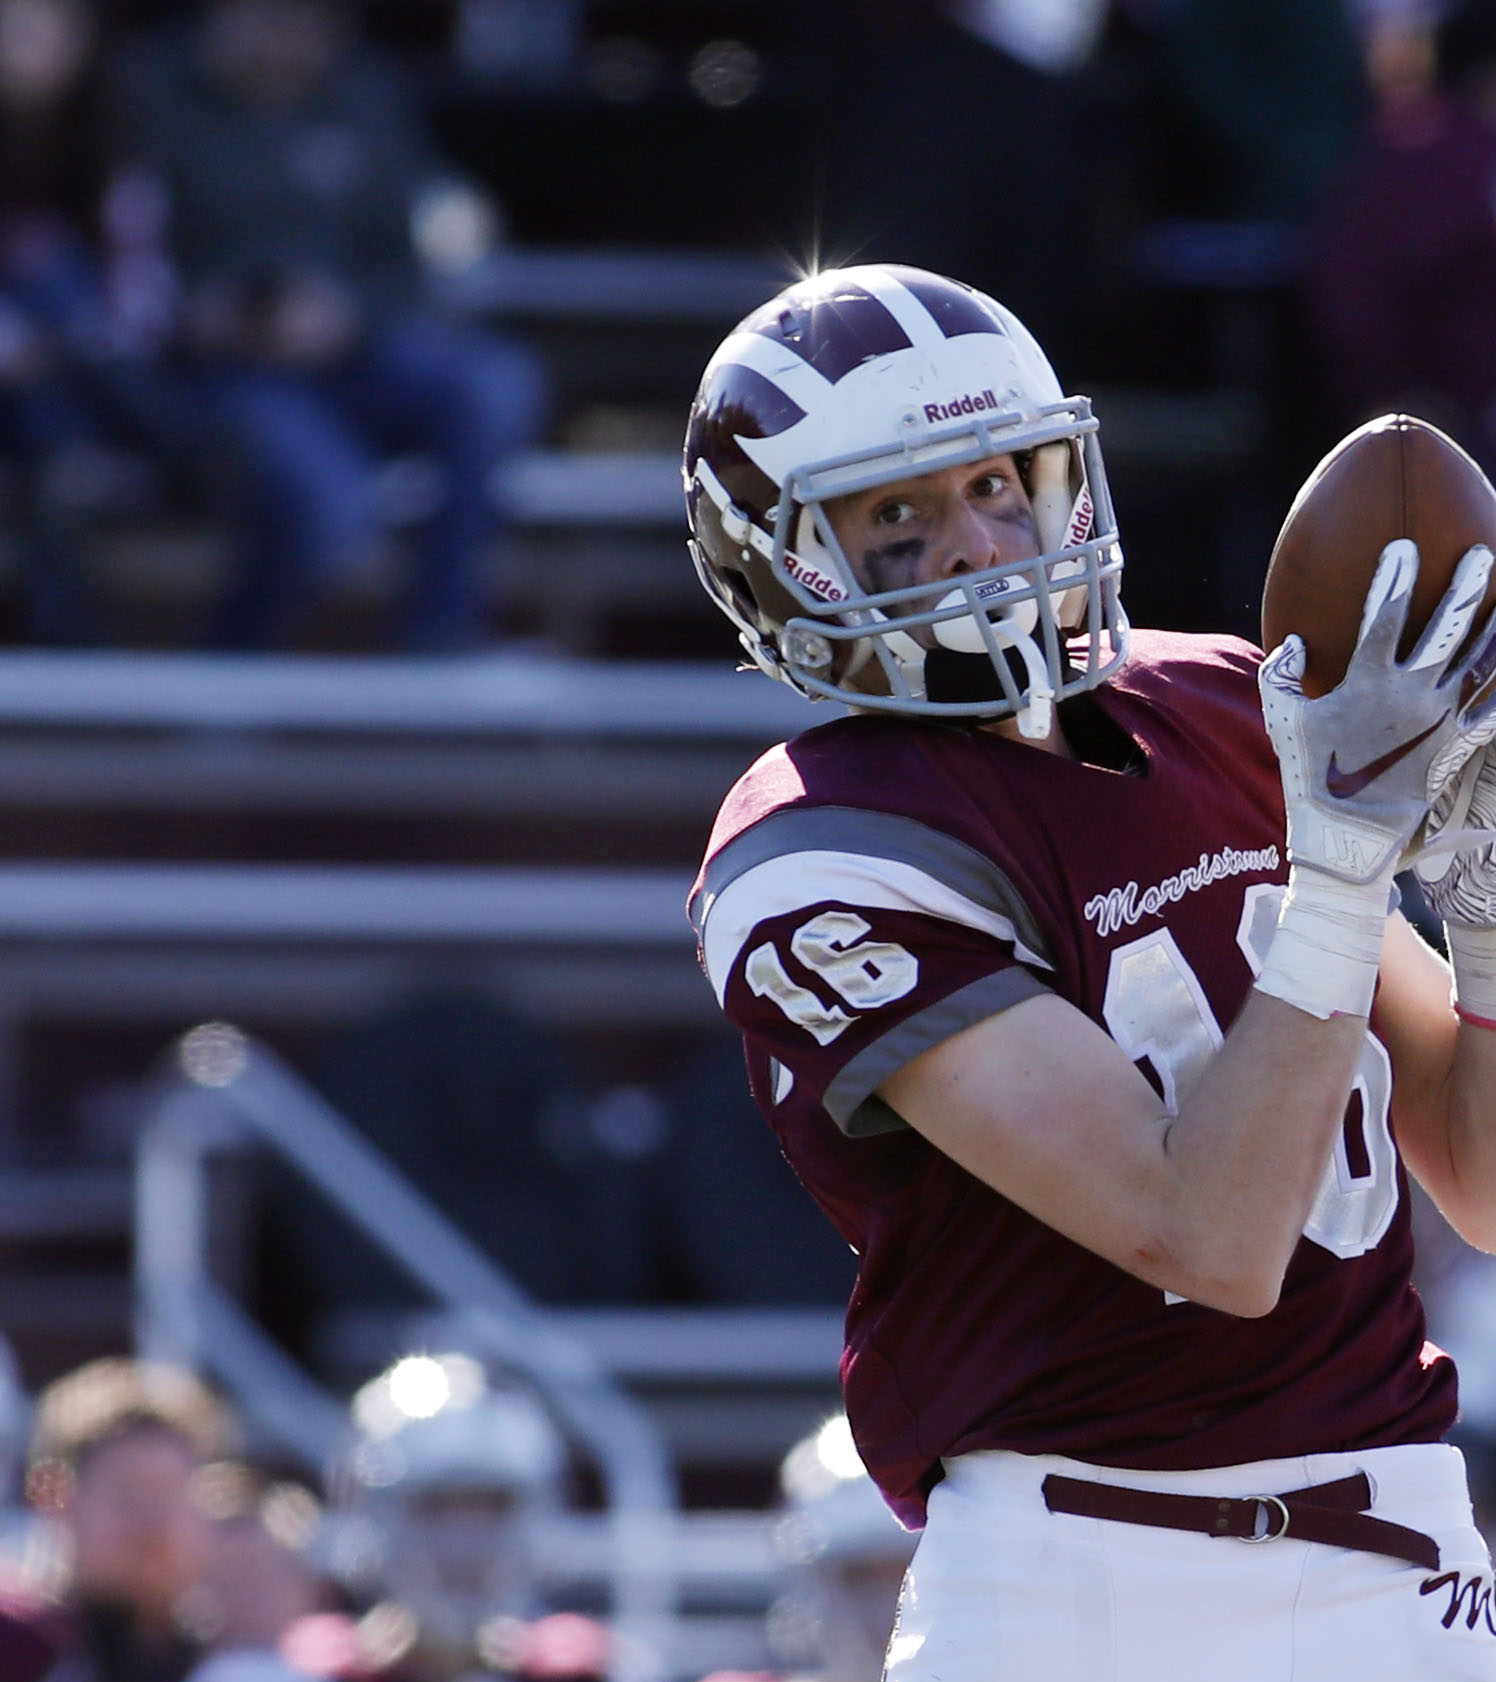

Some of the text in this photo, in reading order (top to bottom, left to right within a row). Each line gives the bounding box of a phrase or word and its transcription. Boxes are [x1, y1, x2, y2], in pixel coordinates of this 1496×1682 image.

[923, 389, 999, 424] Riddell
[1083, 844, 1281, 938] Morristown
[744, 910, 919, 1047] 16
